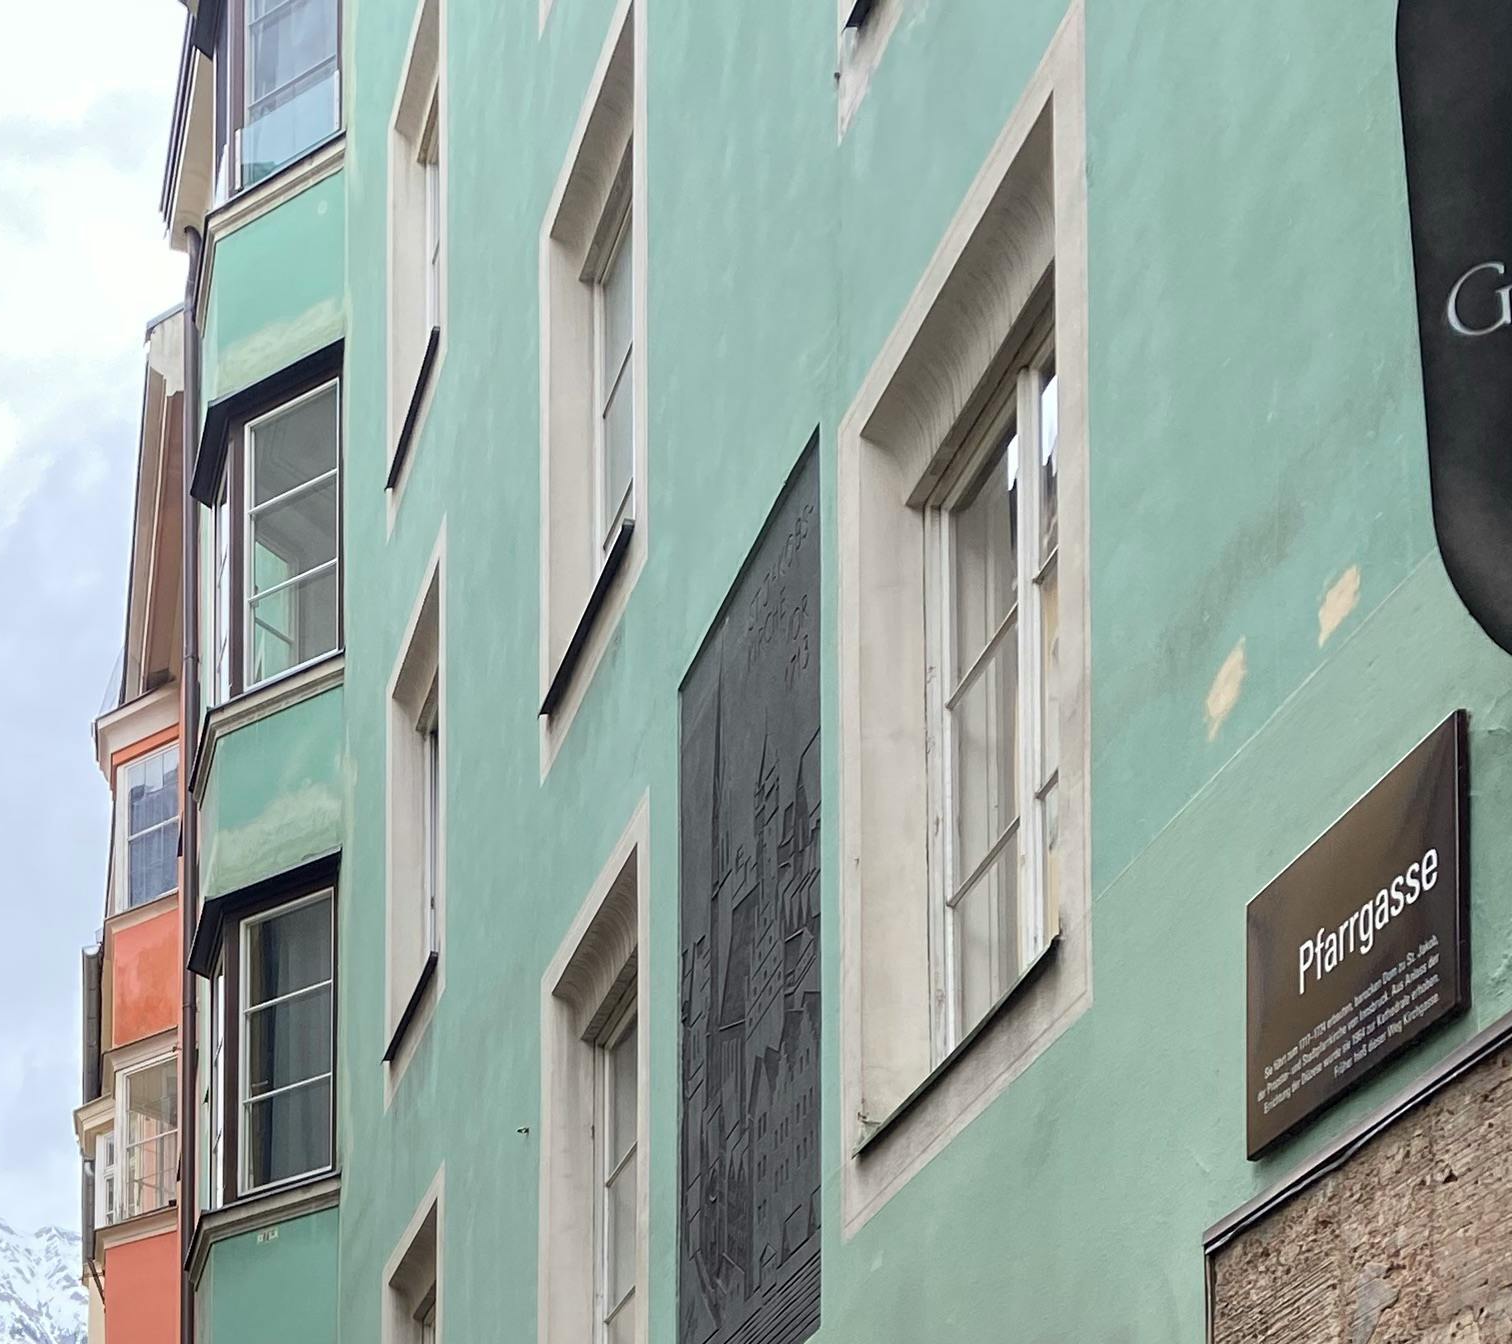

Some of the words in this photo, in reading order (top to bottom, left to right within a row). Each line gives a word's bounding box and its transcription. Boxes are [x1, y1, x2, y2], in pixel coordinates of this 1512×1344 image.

[1299, 848, 1438, 995] Pfarrgasse
[1383, 967, 1398, 985] Dom
[1391, 980, 1404, 996] Aus
[1428, 953, 1439, 969] der
[1377, 995, 1410, 1026] Kathedrale
[1387, 1020, 1403, 1037] Weg
